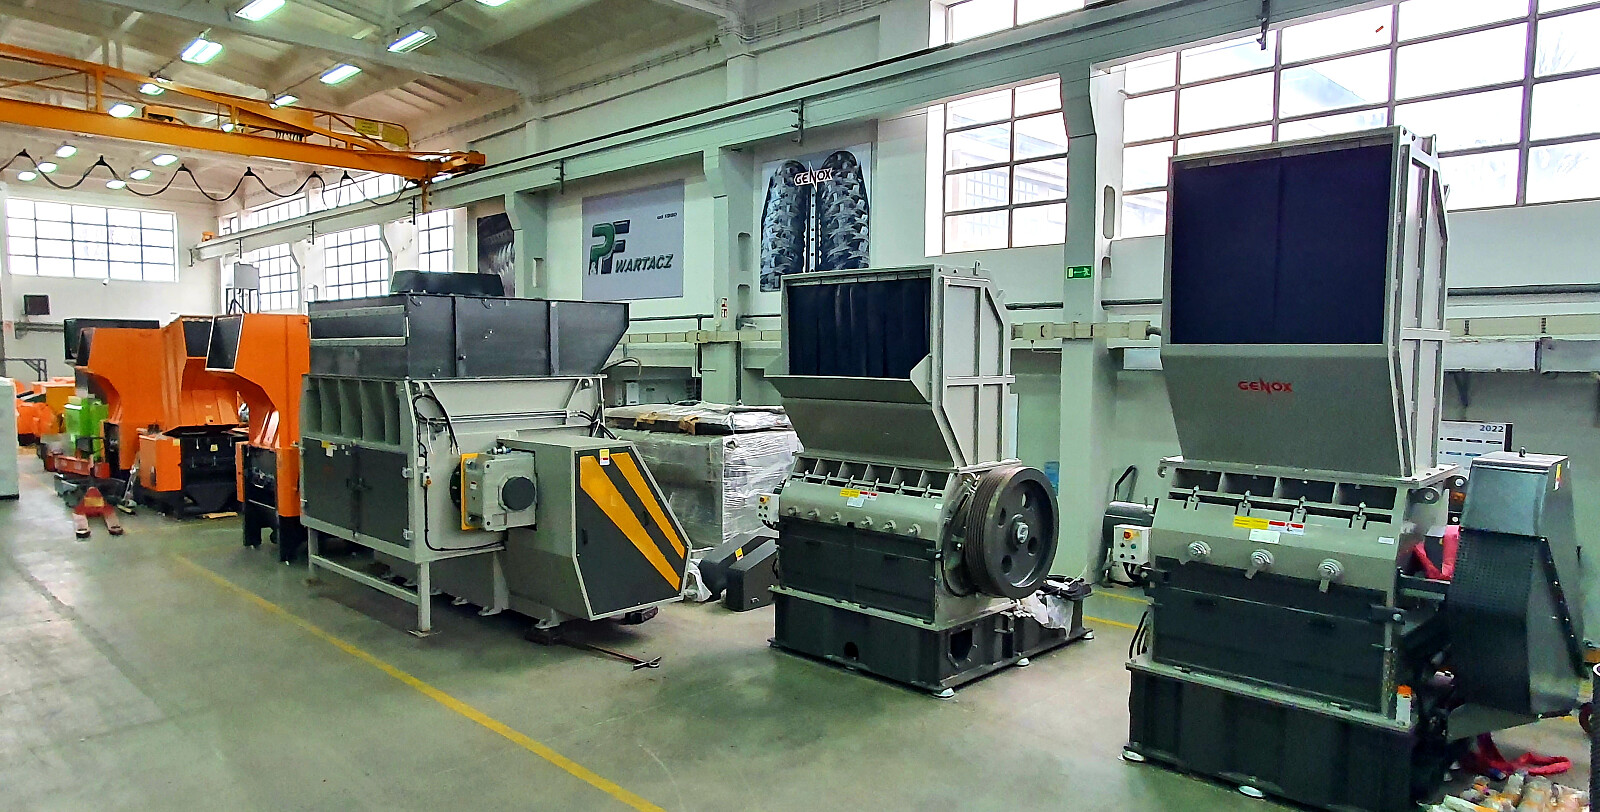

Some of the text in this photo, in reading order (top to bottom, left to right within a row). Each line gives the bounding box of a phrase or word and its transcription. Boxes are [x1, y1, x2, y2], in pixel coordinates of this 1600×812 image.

[794, 163, 833, 190] GENOX
[615, 254, 674, 273] WARTACZ
[1238, 378, 1293, 394] GENOX
[1479, 424, 1504, 433] 2022
